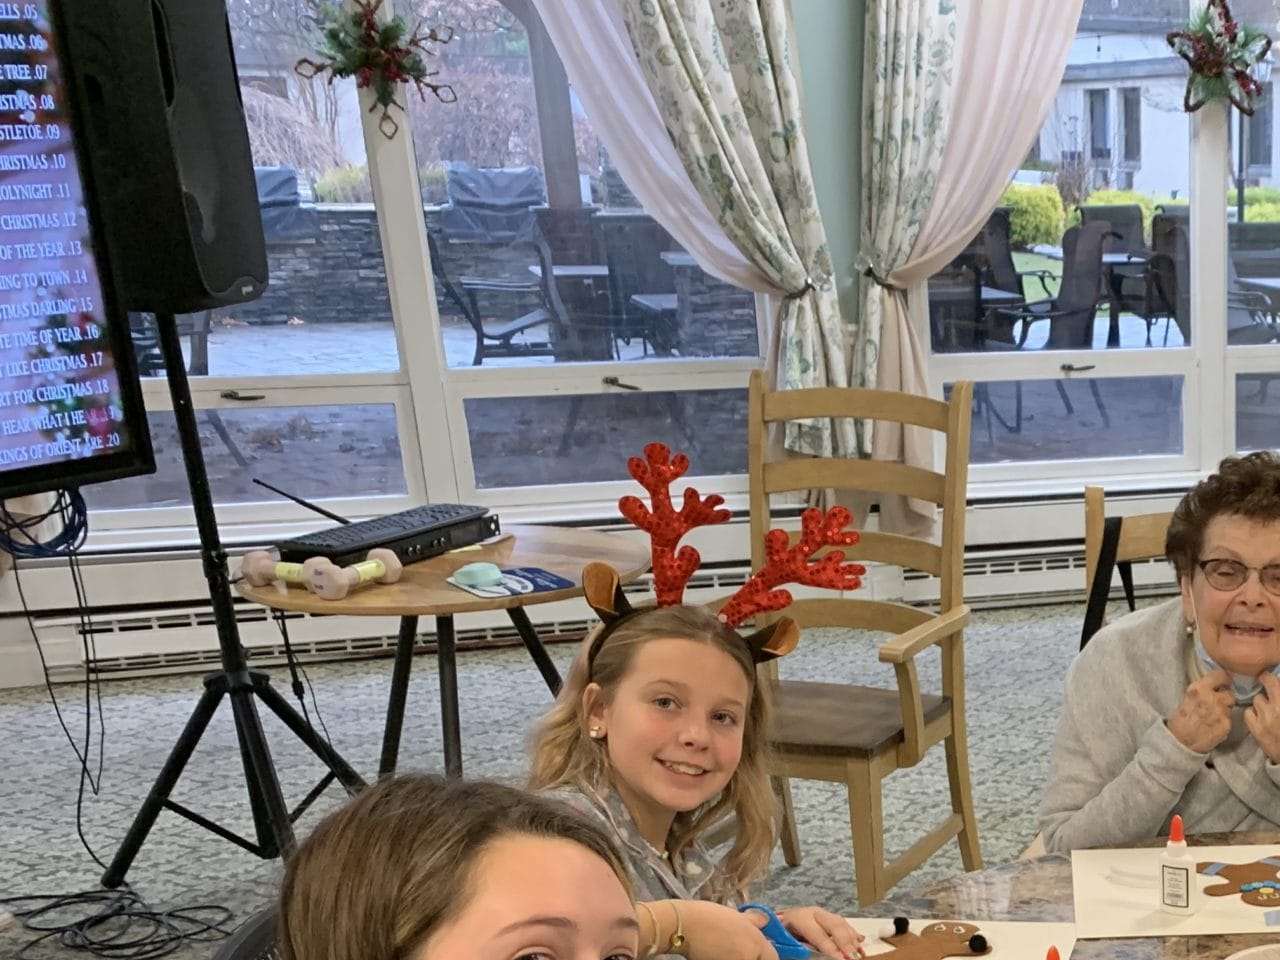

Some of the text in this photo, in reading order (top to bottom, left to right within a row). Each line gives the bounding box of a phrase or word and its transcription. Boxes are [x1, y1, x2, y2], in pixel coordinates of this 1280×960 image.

[4, 64, 31, 80] TREE
[34, 64, 48, 80] .07
[39, 94, 55, 110] .08
[45, 124, 60, 140] .09
[51, 153, 66, 169] .10
[0, 183, 71, 200] OLYNIGHT .11
[1, 211, 78, 230] CHRISTMAS .12
[0, 240, 82, 260] OF THE YEAR .13
[0, 268, 88, 290] ING TO TOWN .14
[0, 302, 30, 319] TMAS
[31, 298, 76, 316] DARLING
[14, 330, 38, 347] TIME
[40, 328, 53, 344] OF
[55, 326, 82, 342] YEAR
[84, 324, 99, 340] .16
[6, 360, 30, 377] LIKE
[31, 353, 87, 374] CHRISTMAS
[90, 351, 103, 367] .17
[13, 389, 35, 405] FOR
[36, 381, 93, 402] CHRISTMAS
[95, 379, 109, 395] .18
[3, 419, 31, 435] HEAR
[33, 413, 62, 430] WHAT
[64, 412, 70, 426] I
[30, 443, 44, 460] OF
[45, 438, 81, 458] ORIENT
[83, 435, 104, 450] ARE
[105, 432, 120, 448] .20
